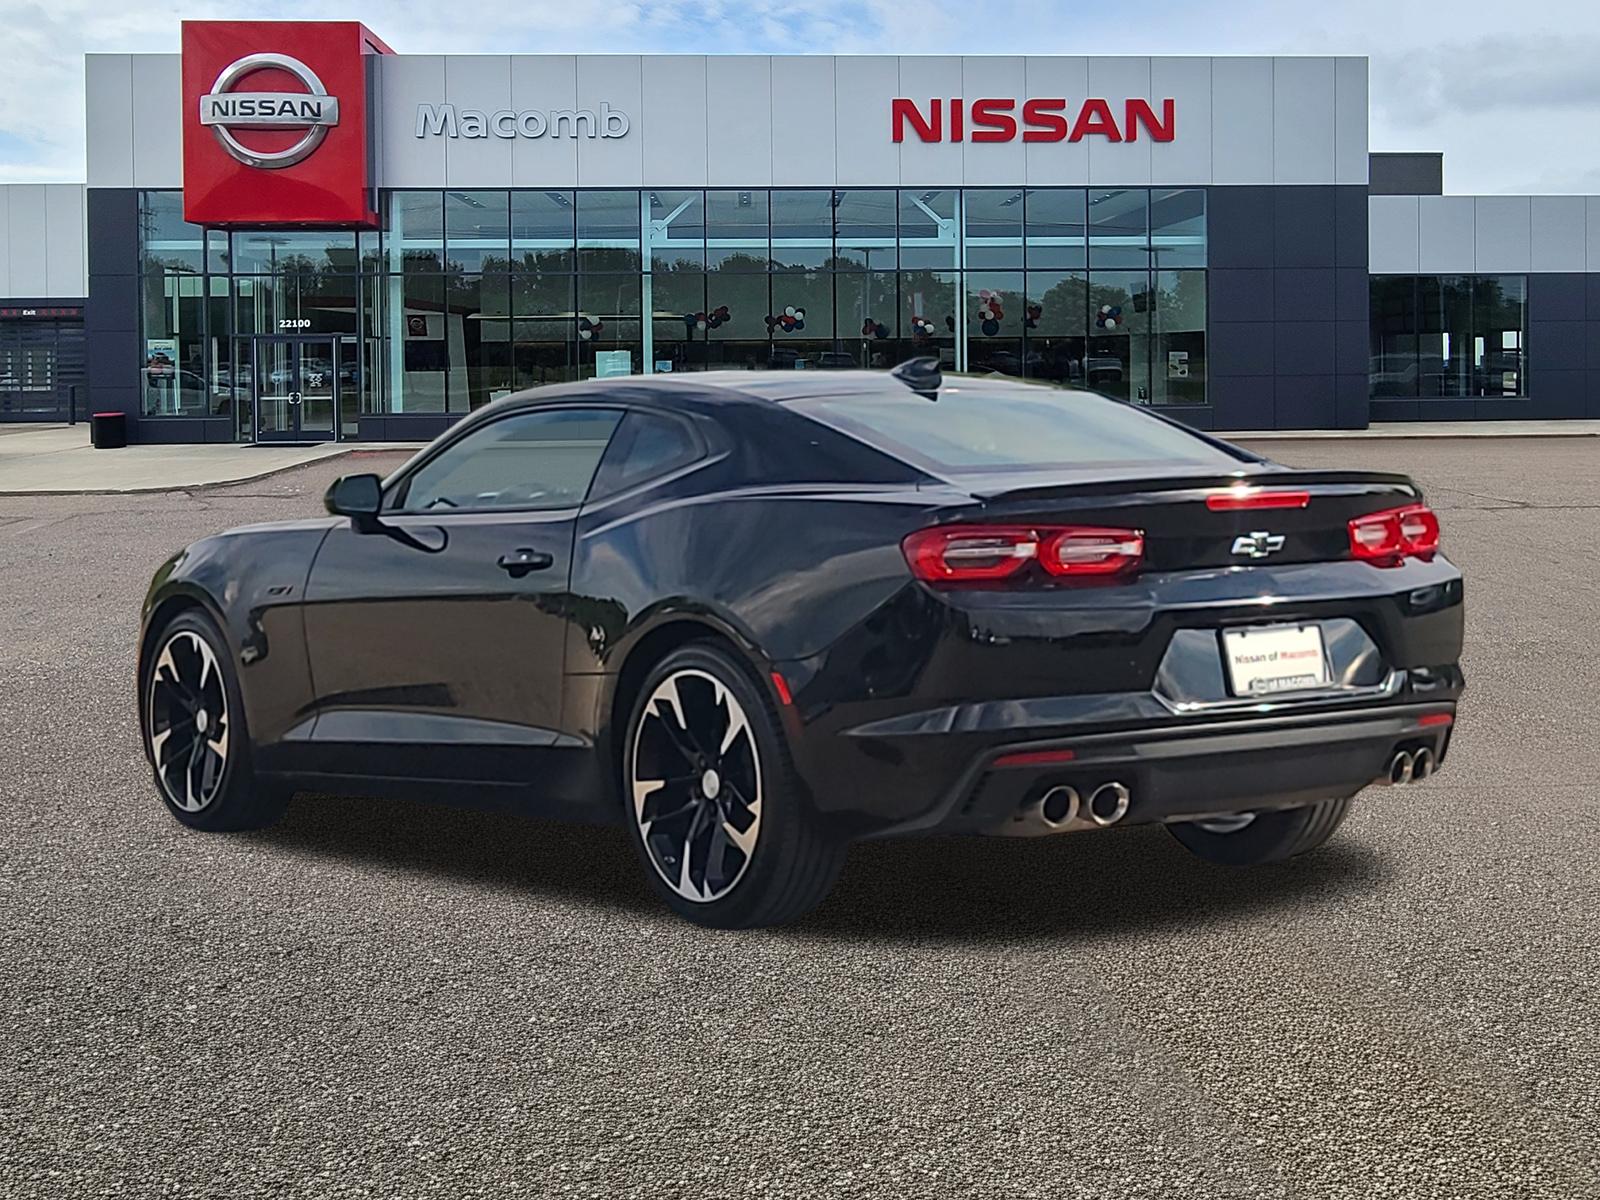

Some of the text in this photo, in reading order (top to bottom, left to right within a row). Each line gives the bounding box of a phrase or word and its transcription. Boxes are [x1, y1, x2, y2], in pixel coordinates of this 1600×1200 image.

[211, 100, 322, 117] NISSAN
[415, 101, 630, 139] Macomb
[892, 98, 1176, 143] NISSAN
[279, 319, 311, 328] 22100
[1235, 654, 1266, 664] Nissan
[1268, 651, 1278, 662] of
